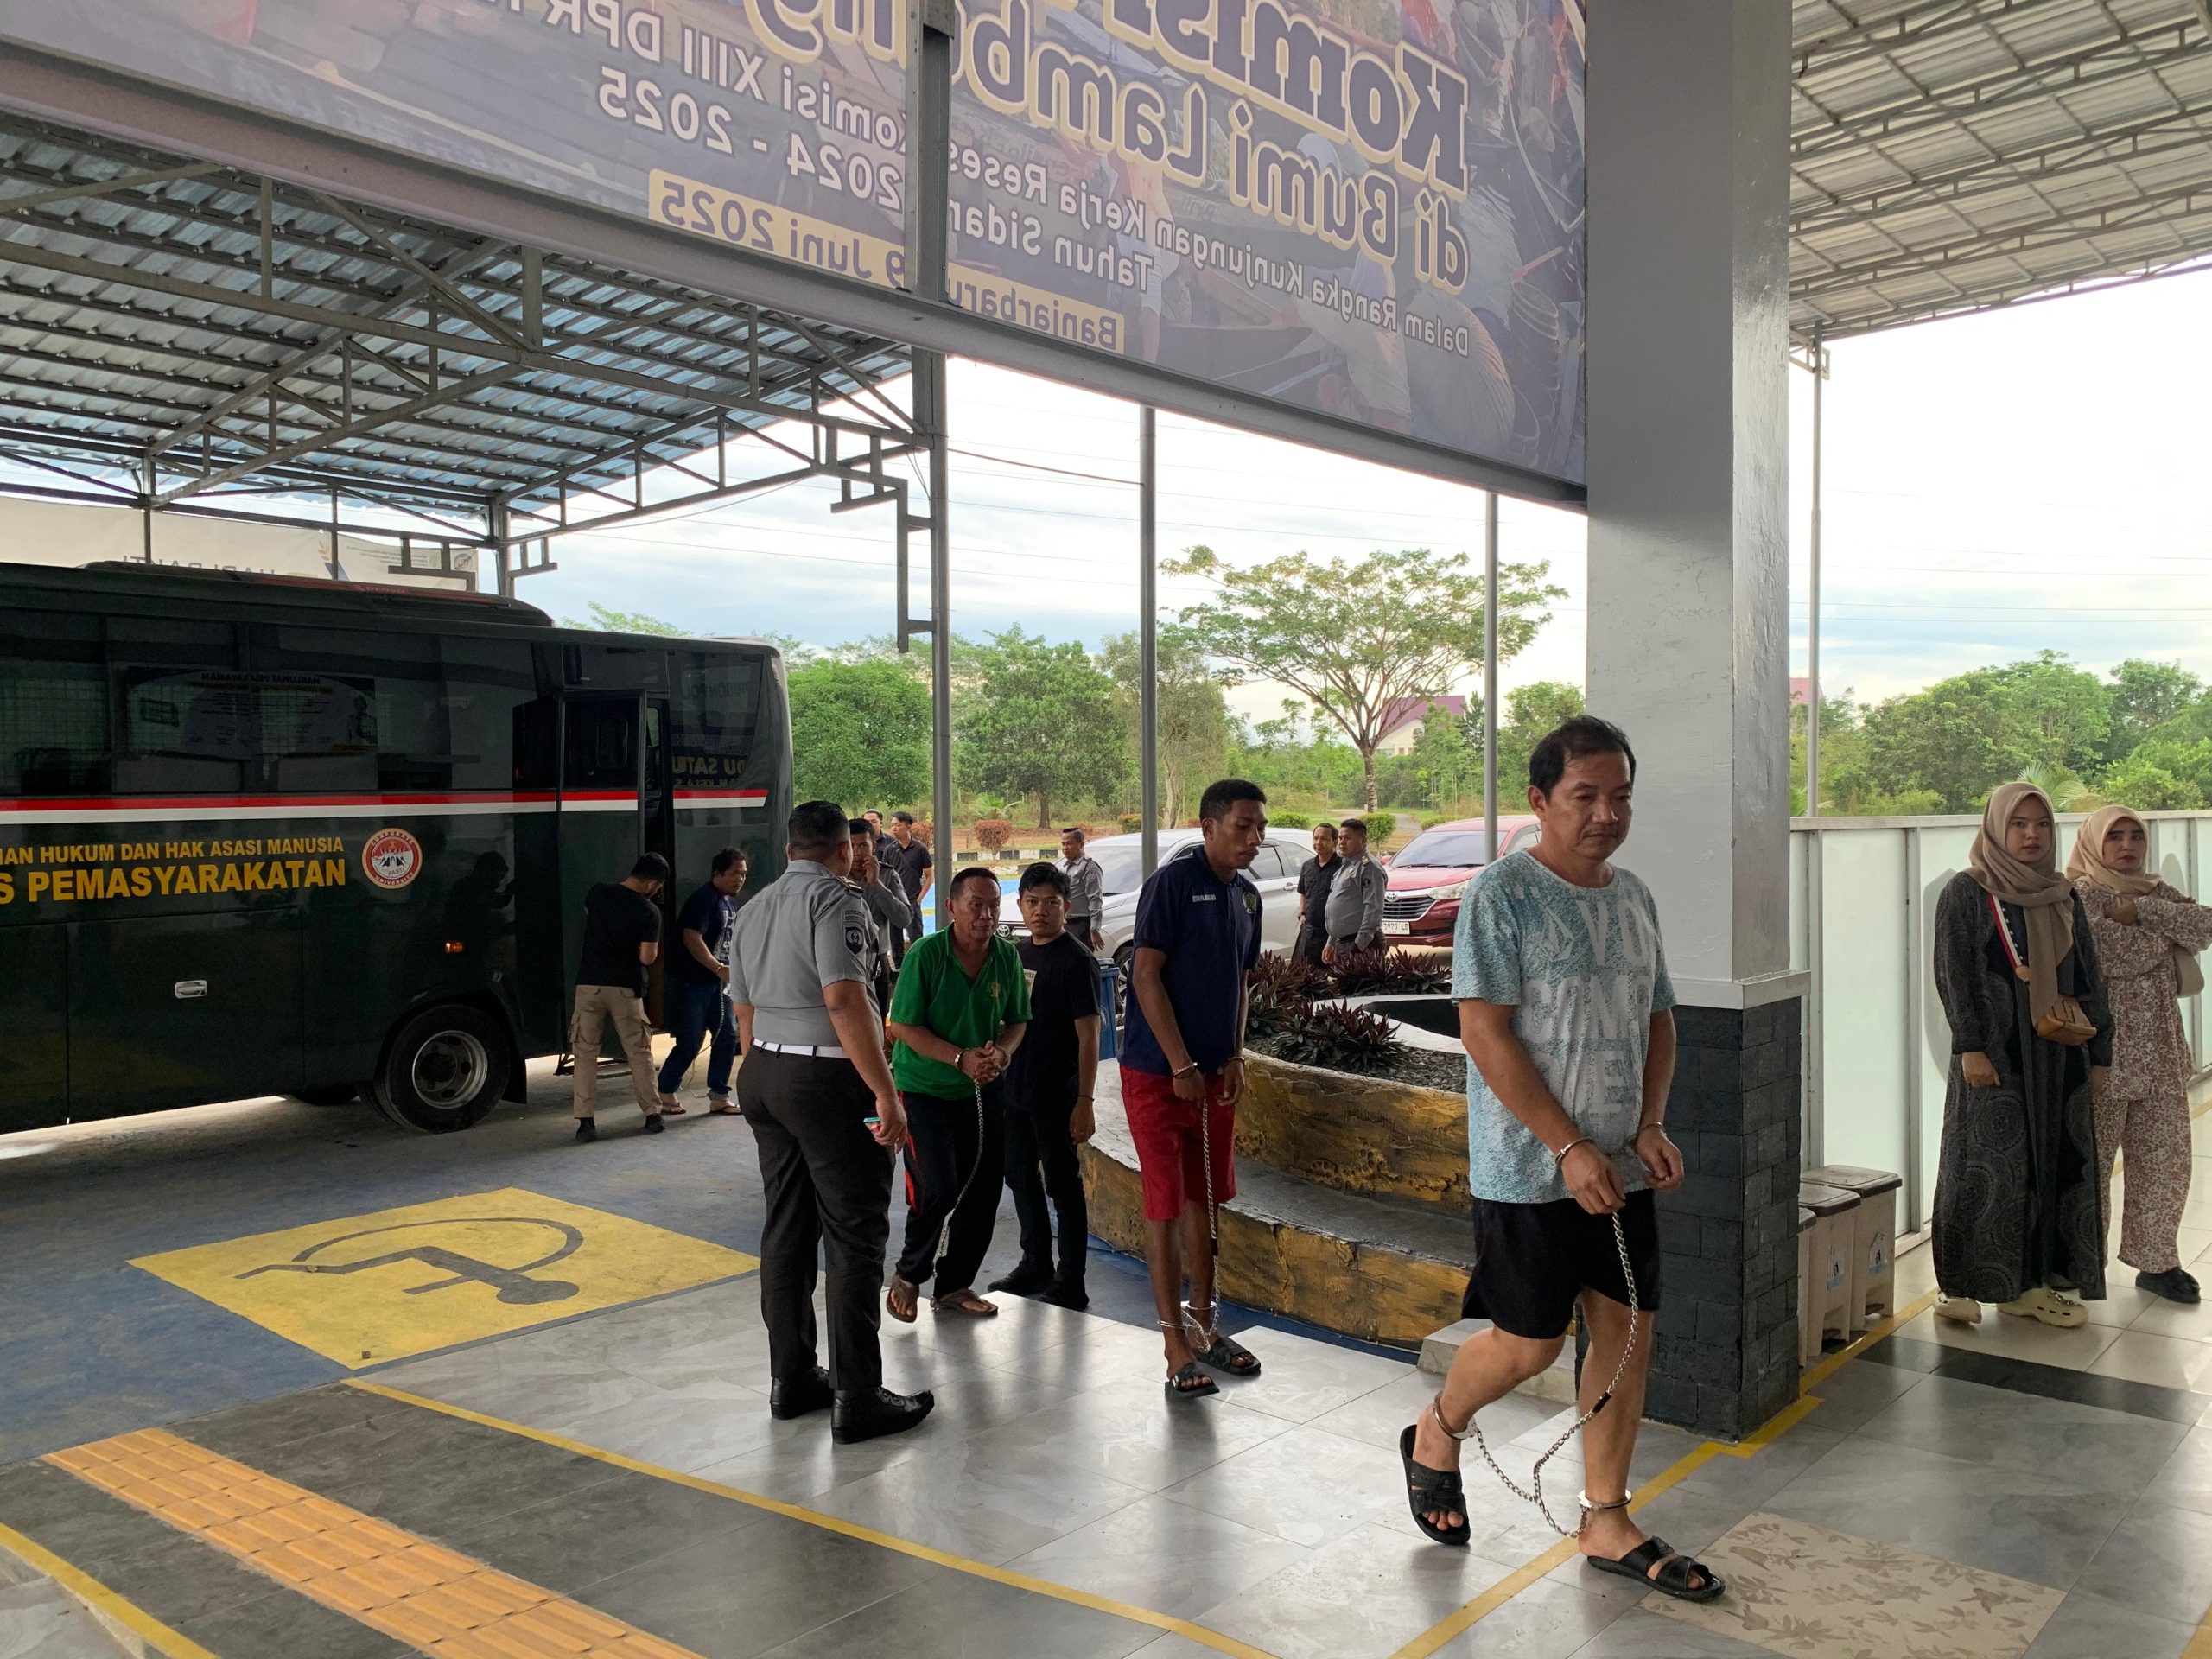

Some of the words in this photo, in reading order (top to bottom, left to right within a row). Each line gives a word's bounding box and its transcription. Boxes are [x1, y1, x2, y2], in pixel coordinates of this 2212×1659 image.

[40, 844, 114, 864] HUKUM
[122, 842, 159, 861] DAN
[165, 841, 204, 859] HAK
[210, 839, 262, 858] ASASI
[267, 836, 344, 855] MANUSIA
[28, 858, 346, 903] PEMASYARAKATAN
